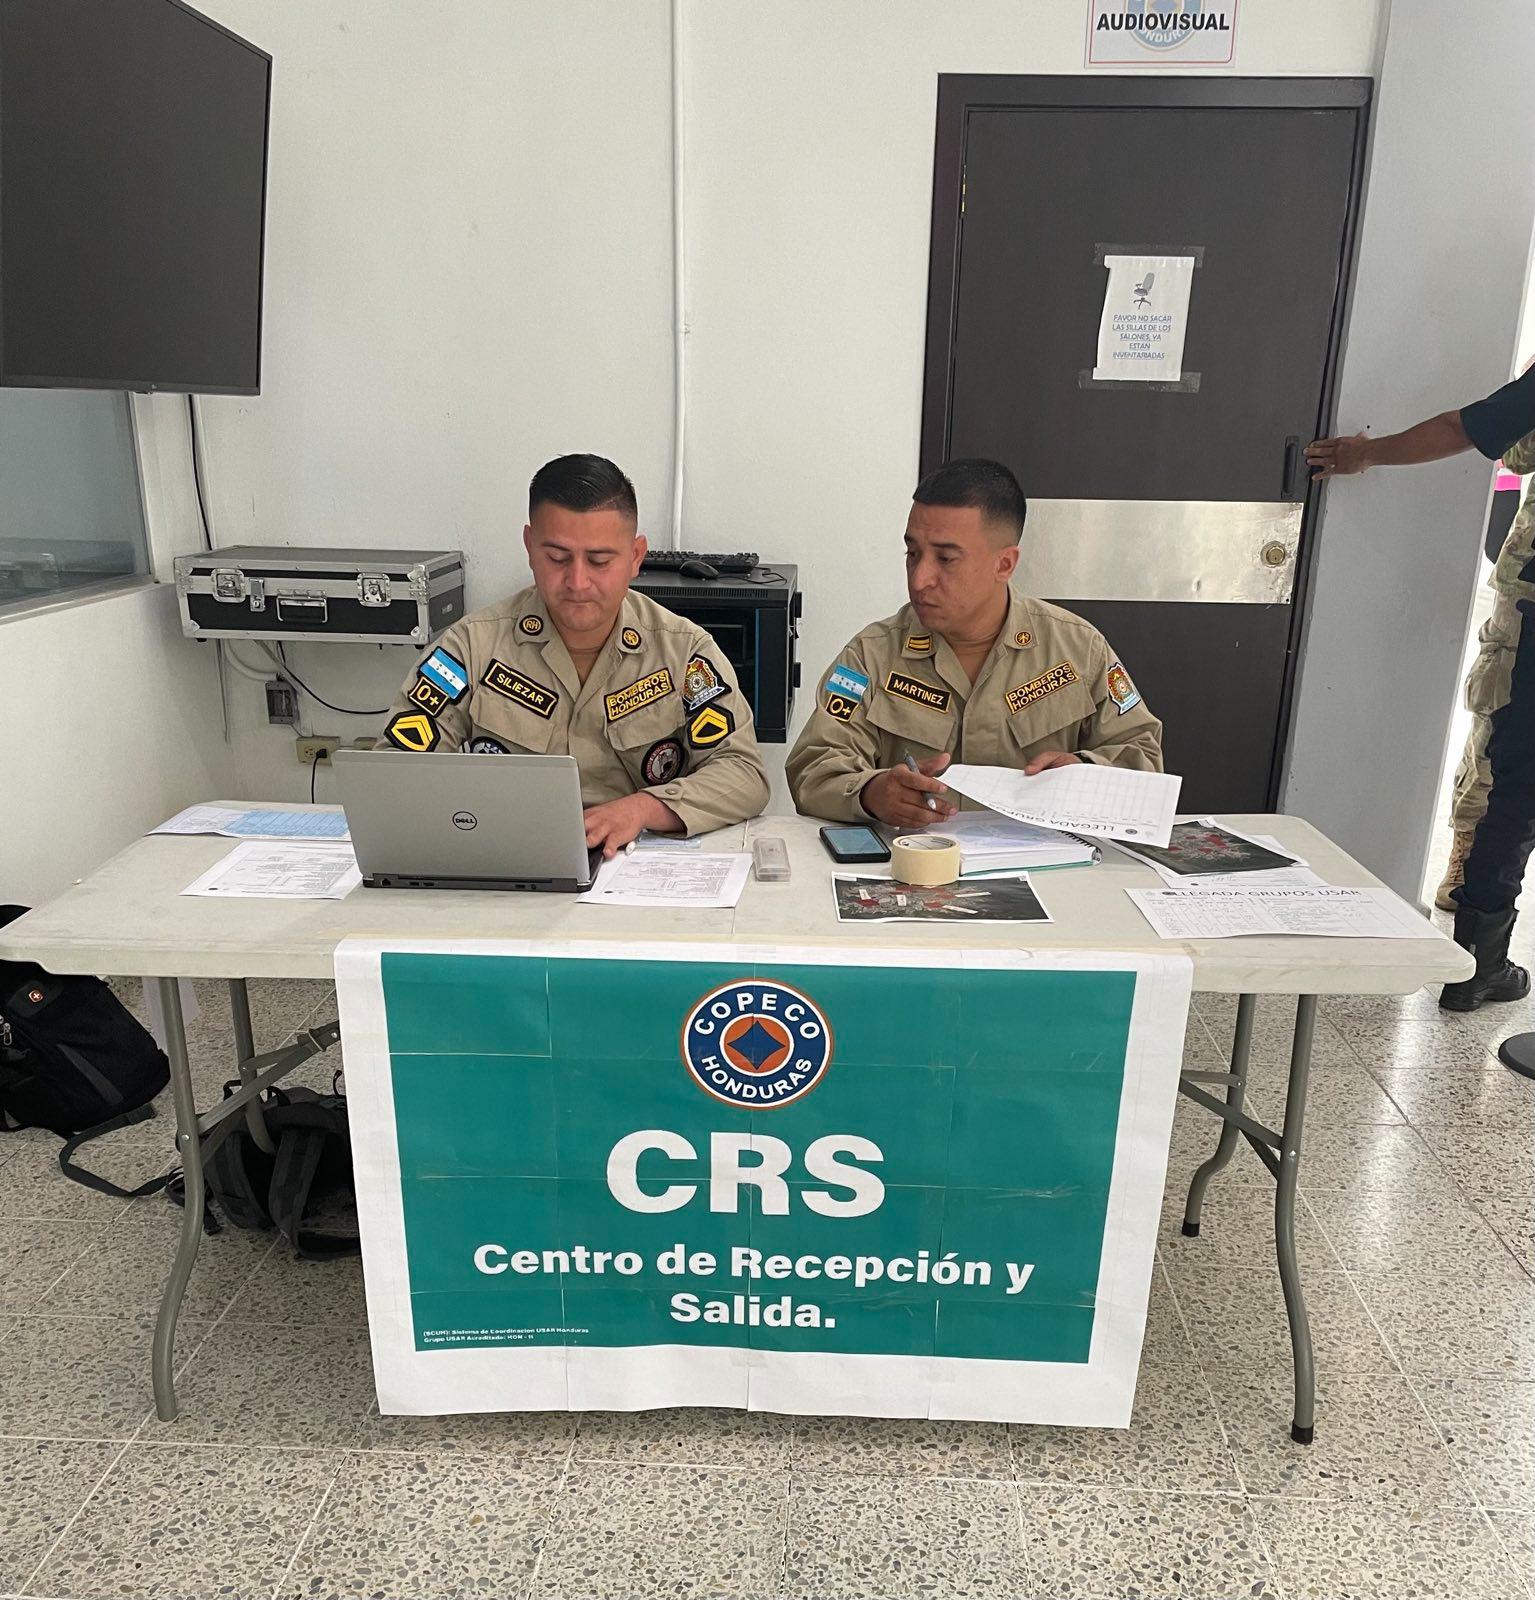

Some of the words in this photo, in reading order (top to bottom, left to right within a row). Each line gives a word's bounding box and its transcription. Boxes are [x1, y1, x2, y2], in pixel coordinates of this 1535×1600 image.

[1097, 13, 1230, 30] AUDIOVISUAL
[1113, 314, 1137, 322] FAVOR
[1158, 324, 1172, 332] LOS
[1112, 351, 1165, 359] INVENTARIADAS
[1129, 342, 1151, 350] ESTAN
[526, 620, 538, 630] RH
[496, 673, 545, 706] SILIEZAR
[609, 671, 667, 708] BOMBEROS
[610, 682, 669, 717] HONDURAS
[893, 679, 945, 705] MARTINEZ
[1008, 665, 1071, 702] BOMBEROS
[1012, 672, 1075, 710] HONDURAS
[1050, 819, 1115, 832] LLEGADA
[694, 992, 820, 1039] COPECO
[701, 1055, 812, 1099] HONDURAS
[606, 1129, 885, 1218] CRS
[473, 1244, 643, 1275] Centro
[656, 1243, 717, 1276] de
[731, 1247, 992, 1288] Recepción
[1005, 1262, 1035, 1294] y
[670, 1293, 836, 1328] Salida.
